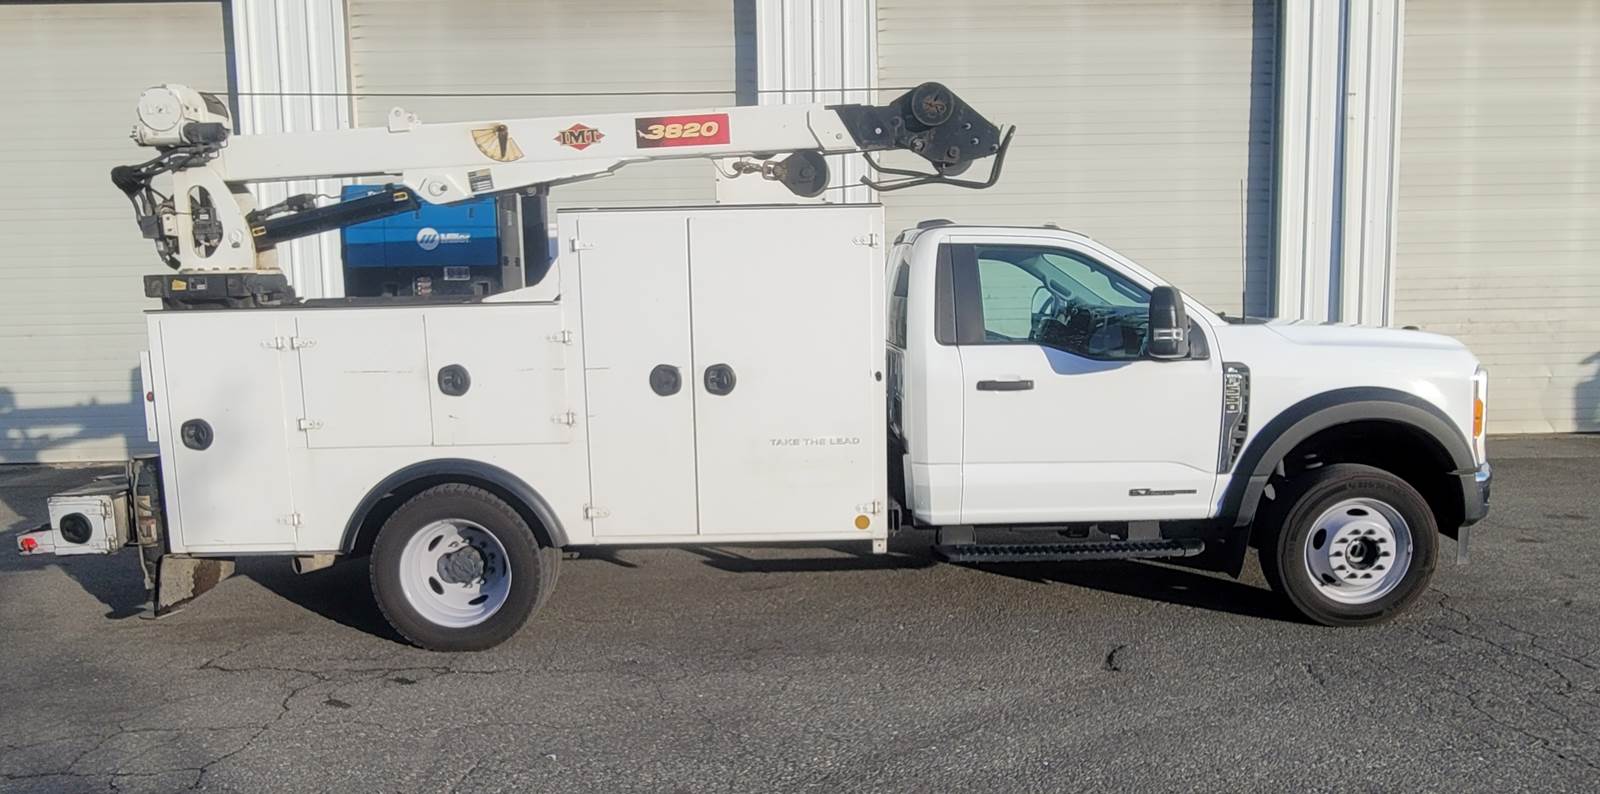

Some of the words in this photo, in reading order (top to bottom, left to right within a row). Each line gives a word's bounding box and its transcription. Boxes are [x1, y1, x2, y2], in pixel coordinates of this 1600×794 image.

[560, 129, 600, 146] IMT
[640, 121, 719, 140] 3820
[769, 438, 800, 446] TAKE
[802, 438, 826, 446] THE
[829, 437, 861, 446] LEAD
